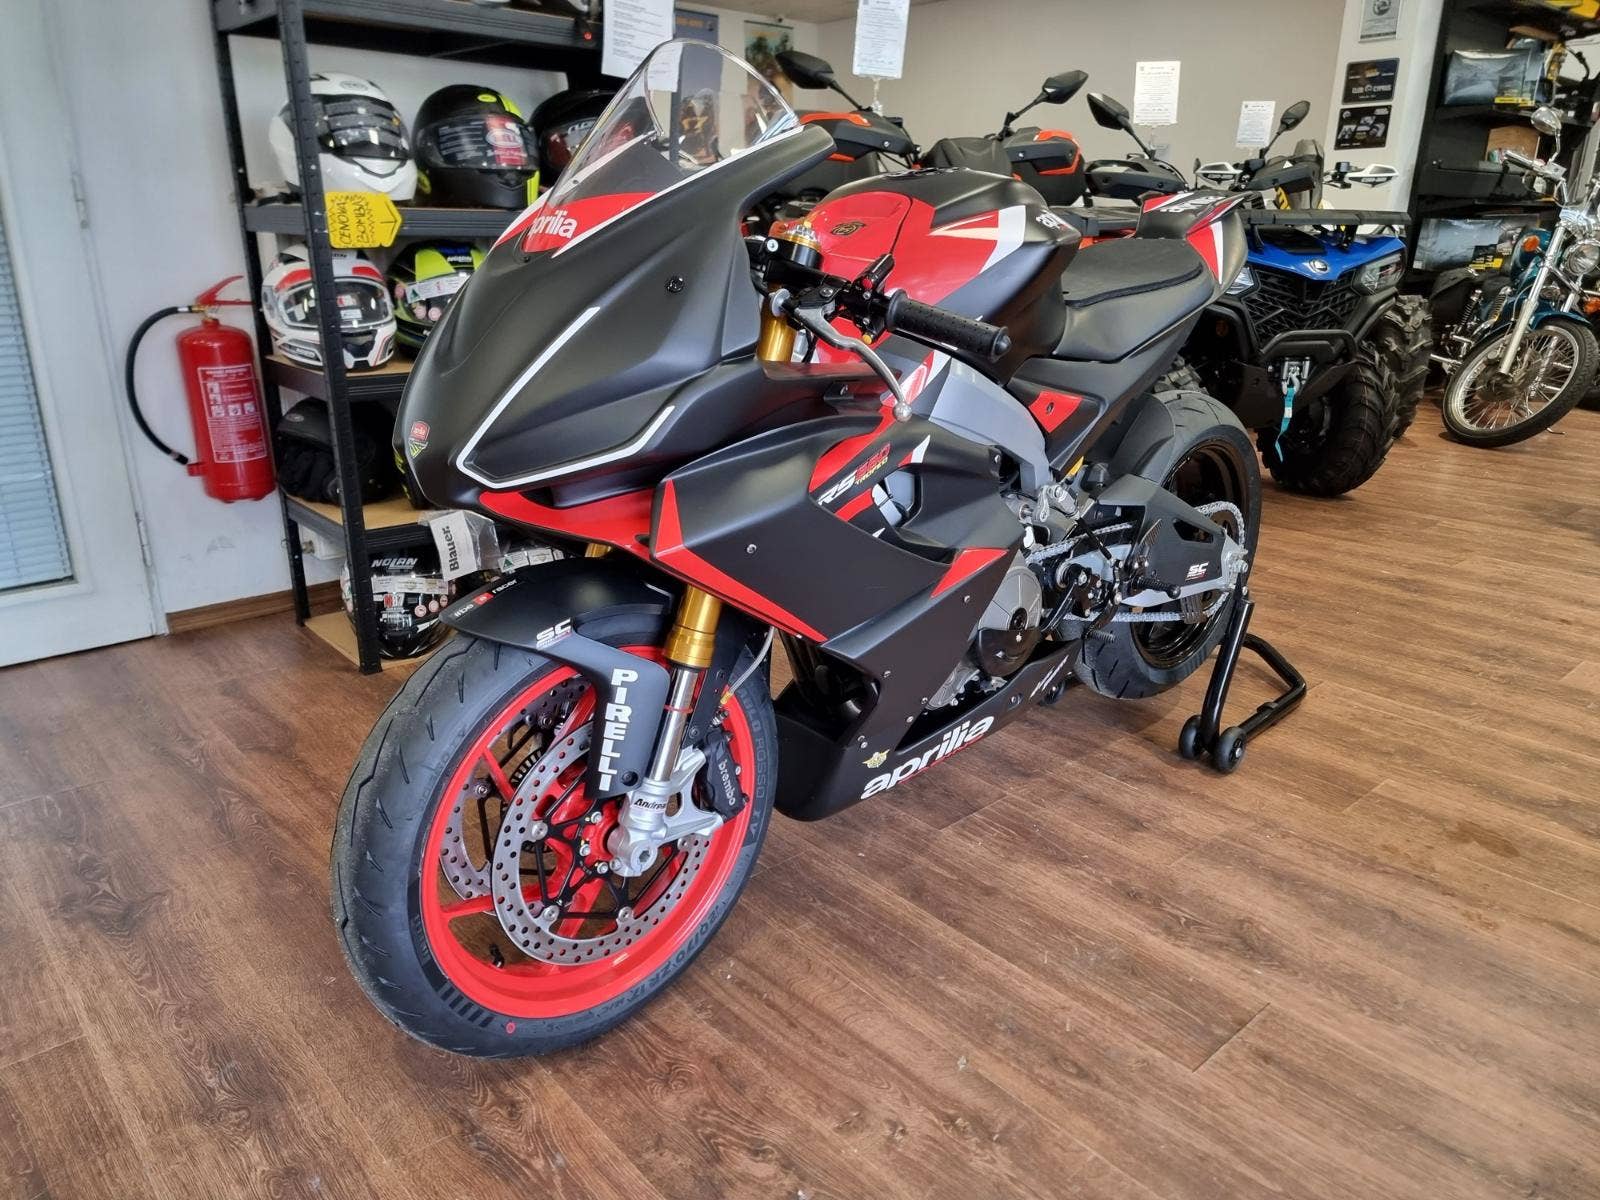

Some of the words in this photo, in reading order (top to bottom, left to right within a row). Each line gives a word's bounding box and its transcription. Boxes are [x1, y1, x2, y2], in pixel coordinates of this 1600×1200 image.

[371, 557, 418, 569] NOLAN
[536, 617, 571, 643] SC
[598, 668, 639, 792] PIRELLI
[718, 759, 736, 806] brembo
[755, 737, 768, 798] ROSSO
[860, 715, 995, 800] aprilia
